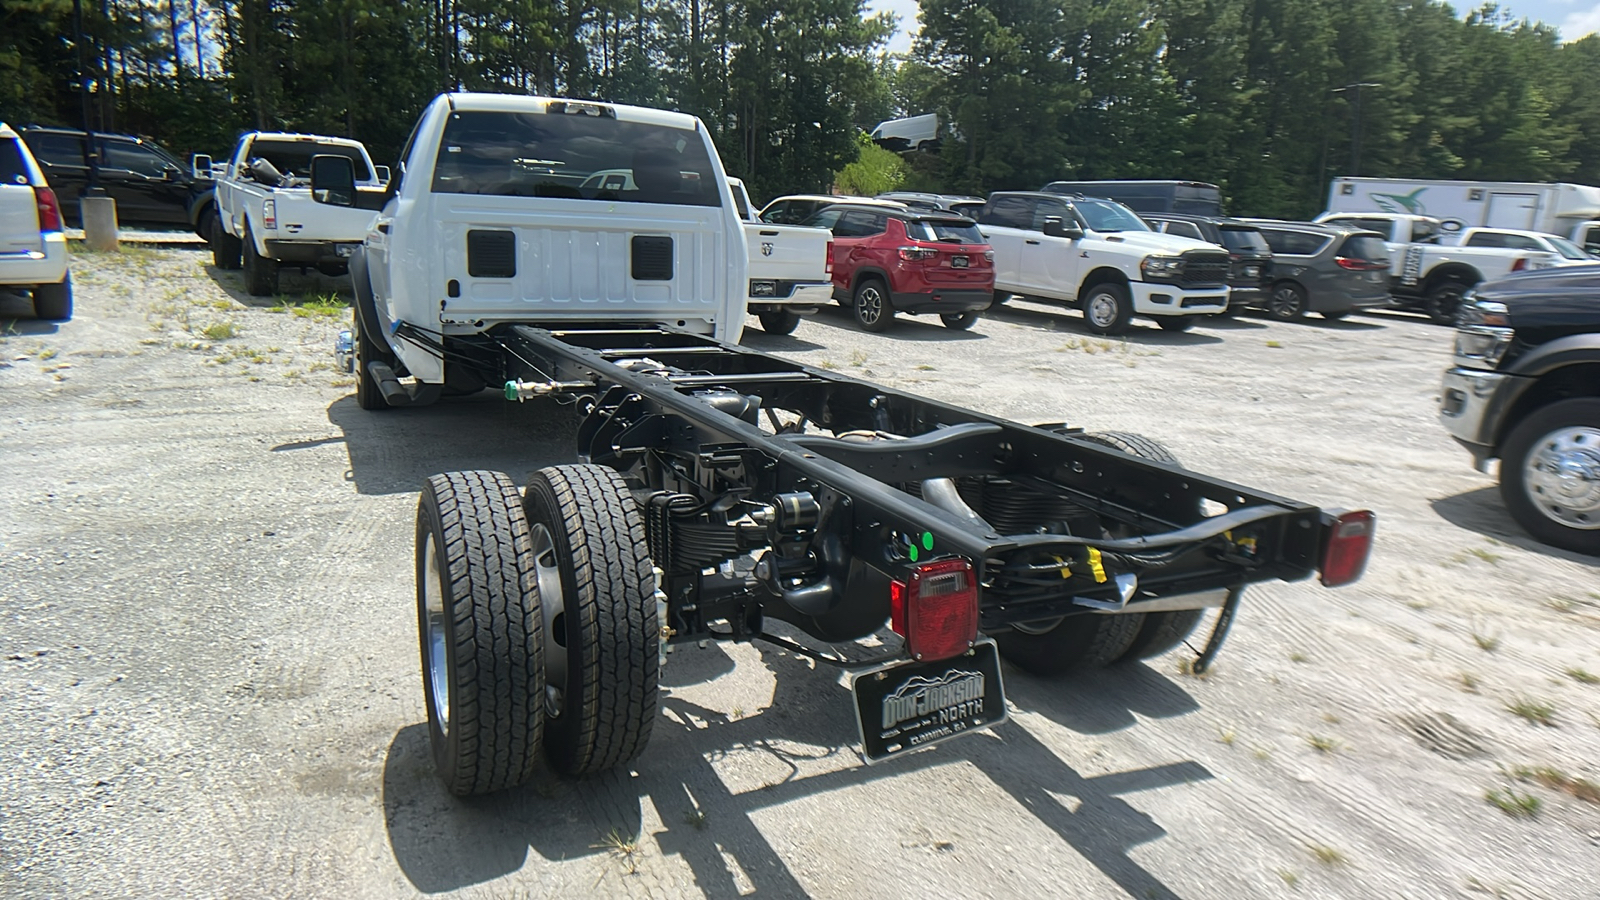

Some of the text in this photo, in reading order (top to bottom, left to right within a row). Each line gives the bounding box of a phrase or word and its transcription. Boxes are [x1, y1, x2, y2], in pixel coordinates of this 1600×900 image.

[883, 676, 985, 729] DON JACKSON
[939, 699, 984, 724] NORTH
[953, 721, 967, 732] GA
